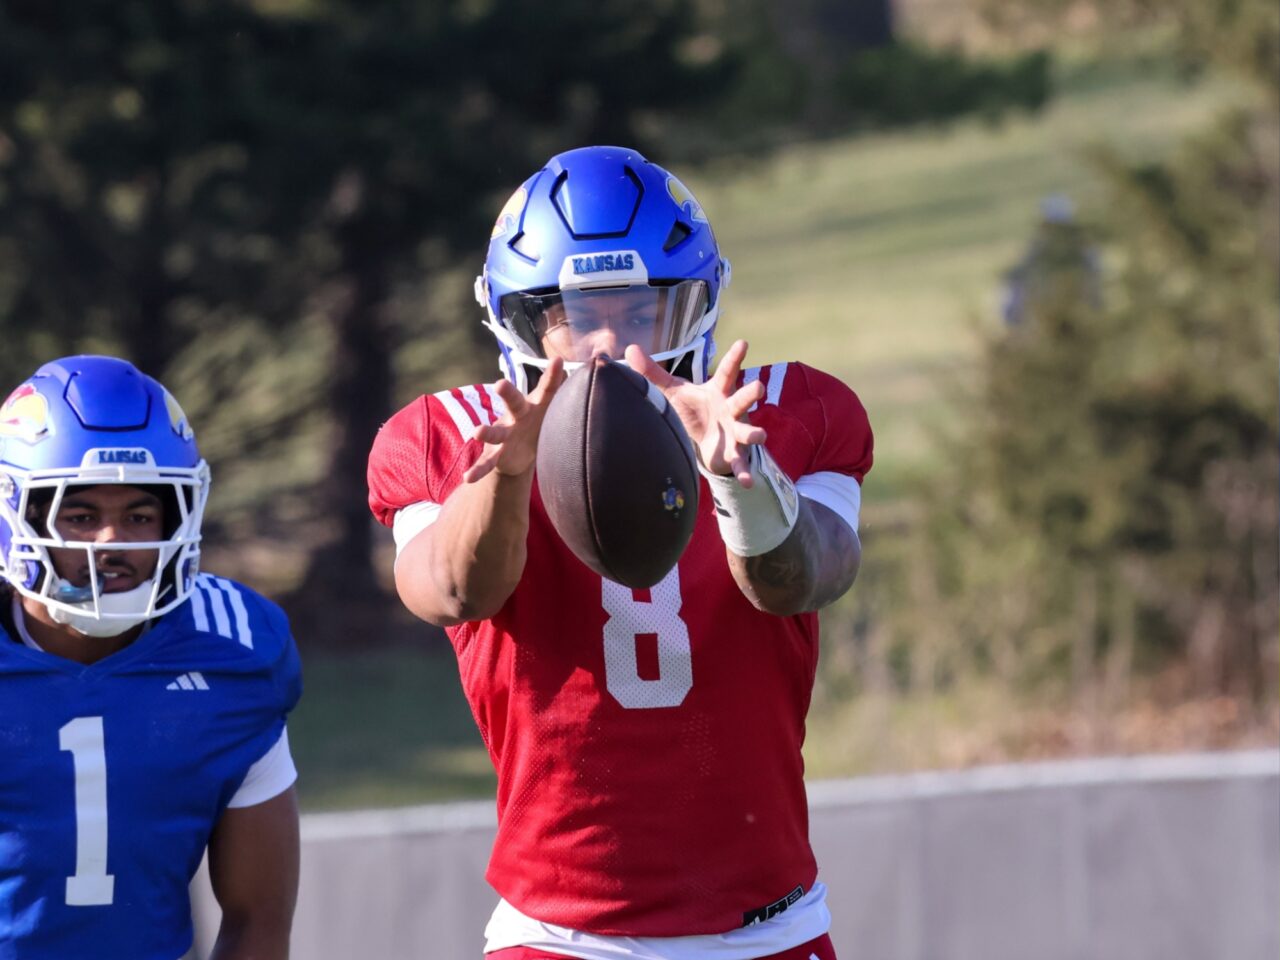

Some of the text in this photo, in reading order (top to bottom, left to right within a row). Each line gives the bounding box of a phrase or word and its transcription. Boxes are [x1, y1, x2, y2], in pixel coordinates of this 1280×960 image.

[572, 254, 634, 275] KANSAS
[99, 450, 147, 464] KANSAS
[601, 562, 693, 709] 8
[58, 716, 114, 906] 1
